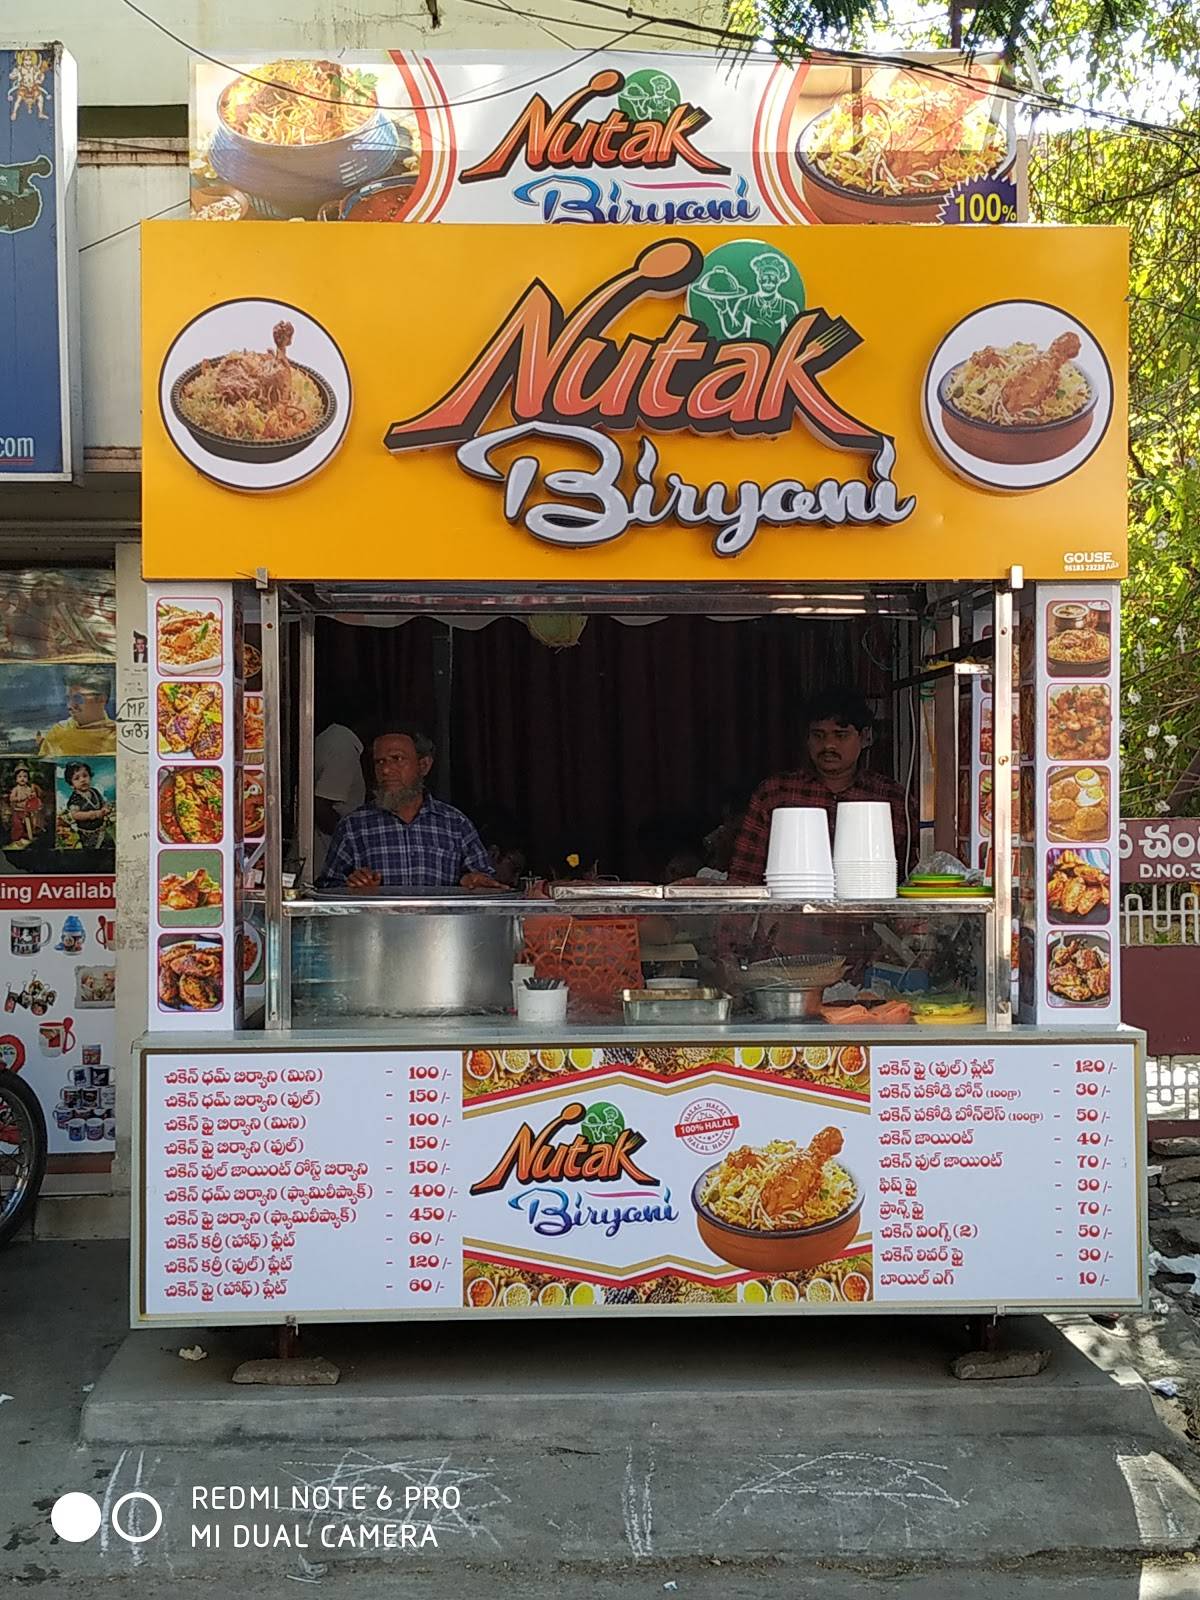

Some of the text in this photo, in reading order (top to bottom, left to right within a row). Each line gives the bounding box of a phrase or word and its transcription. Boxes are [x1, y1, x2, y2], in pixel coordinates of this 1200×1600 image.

[459, 69, 731, 183] Nutak
[513, 173, 759, 223] Biryani
[954, 193, 1017, 223] 100%
[384, 238, 896, 453] Nutak
[456, 420, 916, 557] Biryani
[1063, 551, 1113, 563] GOUSE
[877, 1059, 911, 1076] చికెన్
[163, 1067, 200, 1085] చికెన్
[233, 1070, 279, 1090] బిర్యాని
[877, 1082, 912, 1099] చికెన్
[163, 1091, 199, 1108] చికెన్
[233, 1093, 278, 1113] బిర్యాని
[877, 1105, 912, 1122] చికెన్
[163, 1114, 199, 1132] చికెన్
[216, 1117, 262, 1137] బిర్యాని
[680, 1118, 734, 1135] 100% HALAL
[878, 1129, 912, 1146] చికెన్
[163, 1138, 199, 1155] చికెన్
[216, 1140, 262, 1160] బిర్యాని
[470, 1102, 660, 1195] Nutak
[878, 1152, 913, 1169] చికెన్
[163, 1161, 199, 1179] చికెన్
[324, 1162, 369, 1182] బిర్యాని
[163, 1185, 199, 1203] చికెన్
[233, 1187, 278, 1207] బిర్యాని
[163, 1209, 199, 1226] చికెన్
[216, 1211, 261, 1231] బిర్యాని
[508, 1187, 679, 1237] Biryani
[163, 1232, 199, 1250] చికెన్
[879, 1222, 914, 1239] చికెన్
[880, 1245, 914, 1262] చికెన్
[163, 1256, 199, 1274] చికెన్
[163, 1280, 199, 1298] చికెన్
